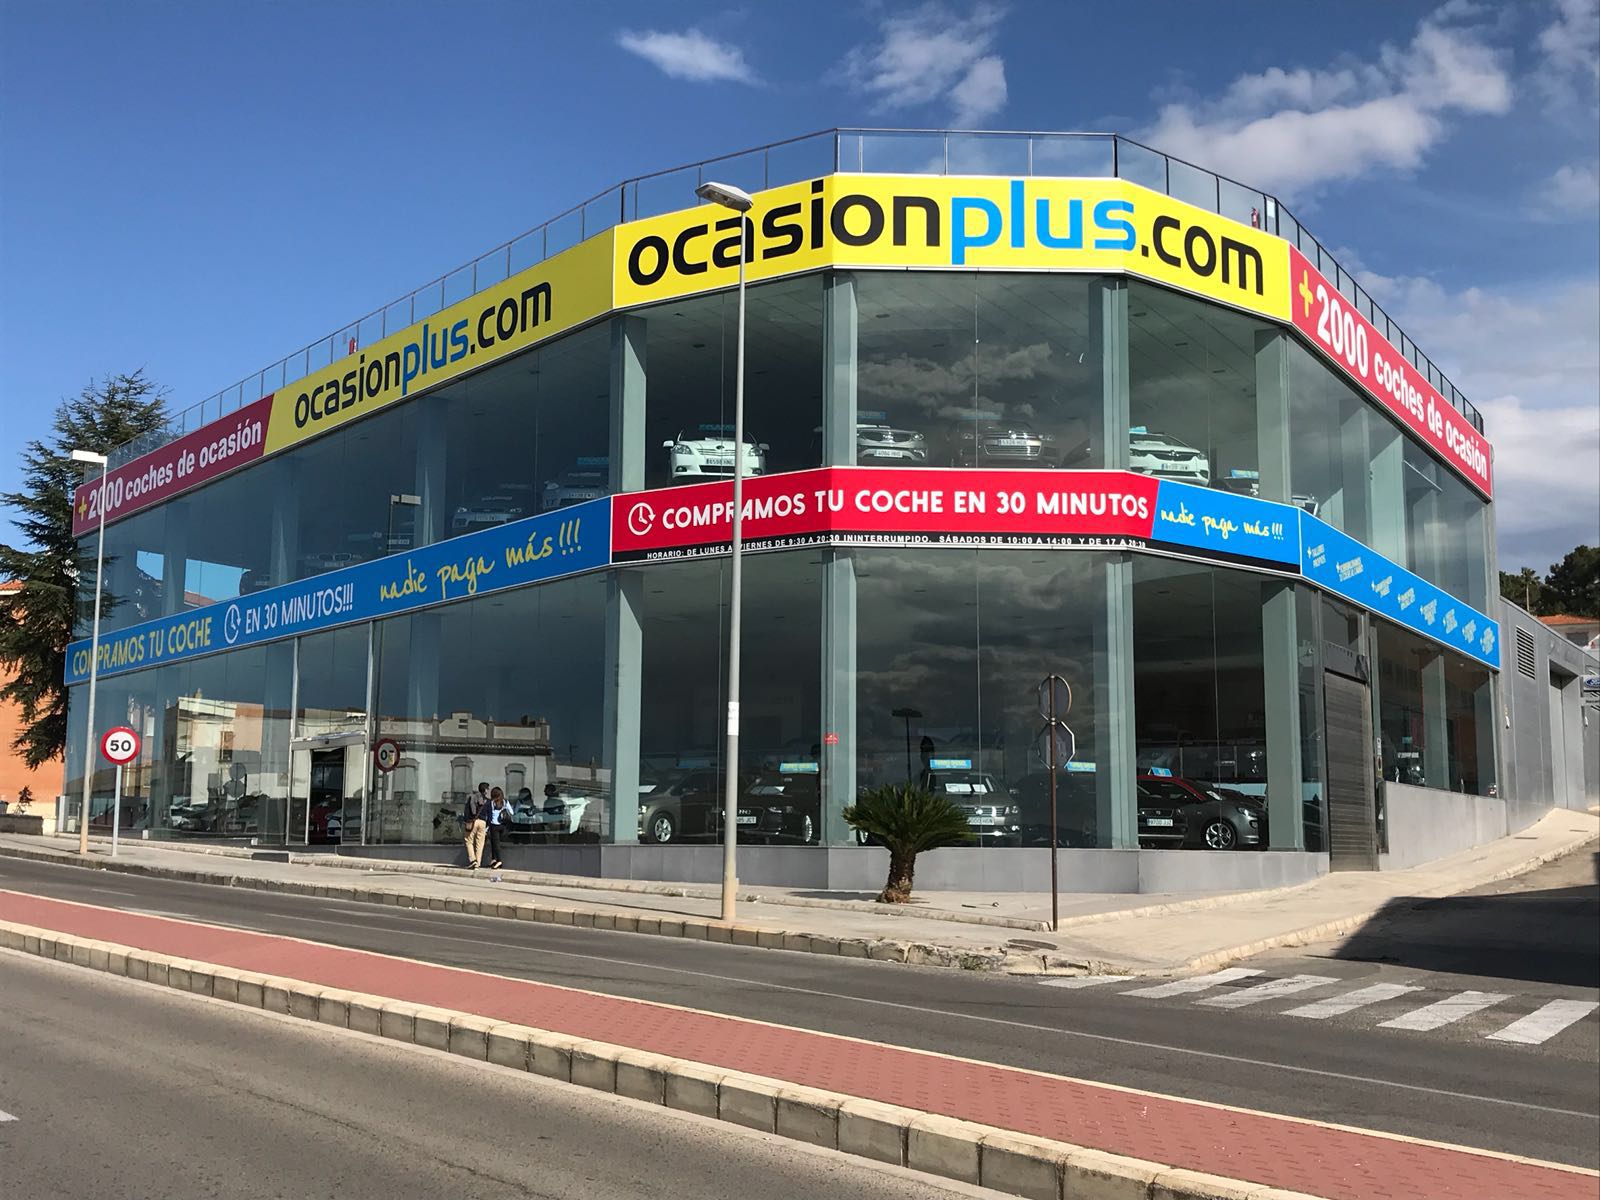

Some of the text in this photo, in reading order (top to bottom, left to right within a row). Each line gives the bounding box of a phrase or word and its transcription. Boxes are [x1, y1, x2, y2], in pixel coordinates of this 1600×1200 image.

[628, 179, 1263, 296] ocasionplus.com
[294, 281, 551, 428] ocasionplus.com
[1316, 284, 1369, 378] 2000
[1374, 352, 1425, 422] coches
[1427, 396, 1443, 439] de
[1445, 420, 1487, 481] ocasión
[125, 463, 173, 500] coches
[177, 449, 195, 478] de
[199, 418, 262, 468] ocasión
[662, 490, 1149, 529] COMPRAMOS TU COCHE EN 30 MINUTOS
[1161, 502, 1196, 526] nadie
[1202, 516, 1238, 540] paga
[647, 551, 684, 559] HORARIO:
[687, 548, 697, 556] DE
[700, 545, 725, 555] LUNES
[727, 545, 733, 553] A
[775, 538, 786, 547] DE
[788, 537, 806, 546] 9:30
[808, 536, 815, 544] A
[816, 534, 840, 543] 20:30
[939, 533, 987, 544] SÁBADOS
[990, 536, 1003, 544] DE
[1007, 536, 1033, 545] 10:00
[1036, 537, 1043, 545] A
[1045, 537, 1072, 546] 14:00
[1078, 537, 1086, 545] Y
[1088, 538, 1102, 546] DE
[1105, 538, 1116, 546] 17
[1120, 538, 1127, 546] A
[380, 559, 427, 602] nadie
[437, 556, 495, 600] paga
[149, 632, 164, 659] TU
[168, 616, 213, 654] COCHE
[245, 607, 260, 635] EN
[263, 602, 278, 630] 30
[281, 583, 354, 624] MINUTOS!!!
[110, 740, 132, 752] 50
